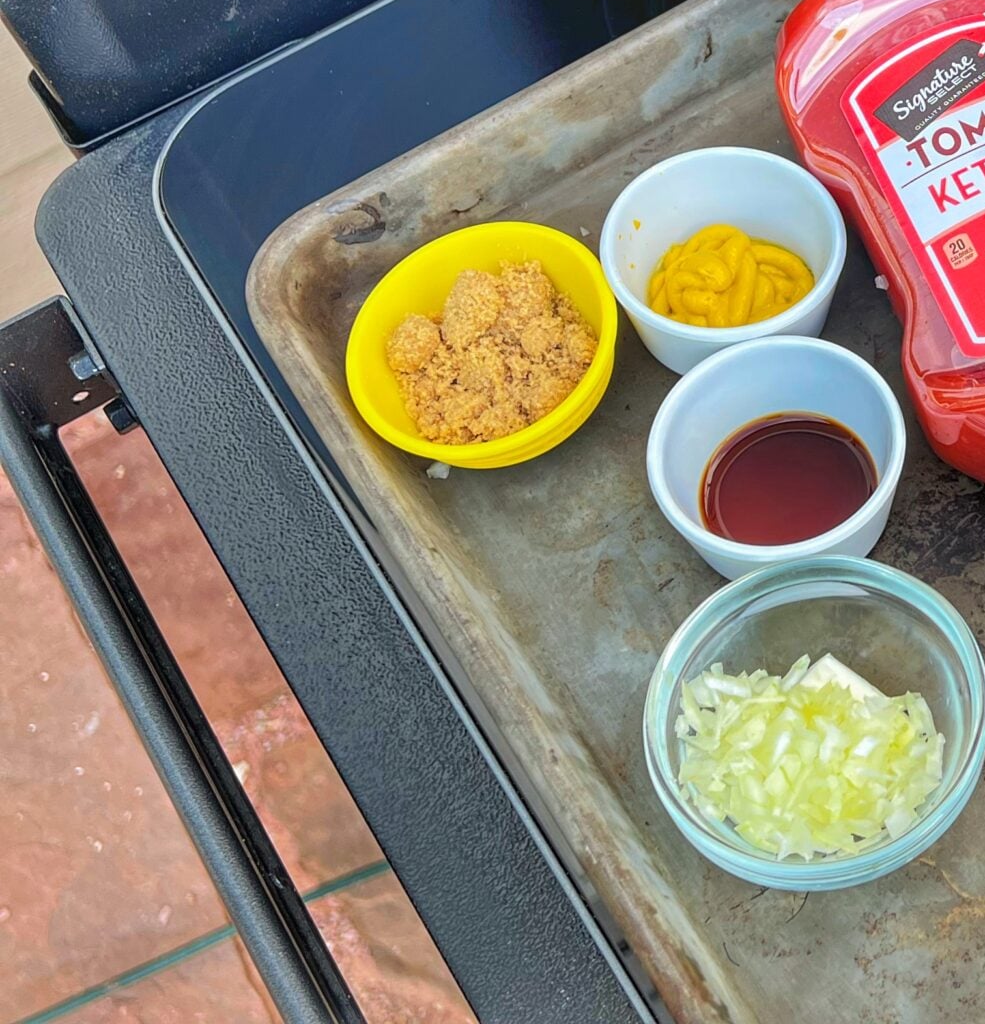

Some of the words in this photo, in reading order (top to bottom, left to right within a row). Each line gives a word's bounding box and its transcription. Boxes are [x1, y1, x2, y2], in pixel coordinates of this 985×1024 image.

[893, 56, 974, 120] Signature
[927, 63, 977, 105] SELECT
[915, 106, 942, 131] QUALITY
[949, 238, 966, 255] 20
